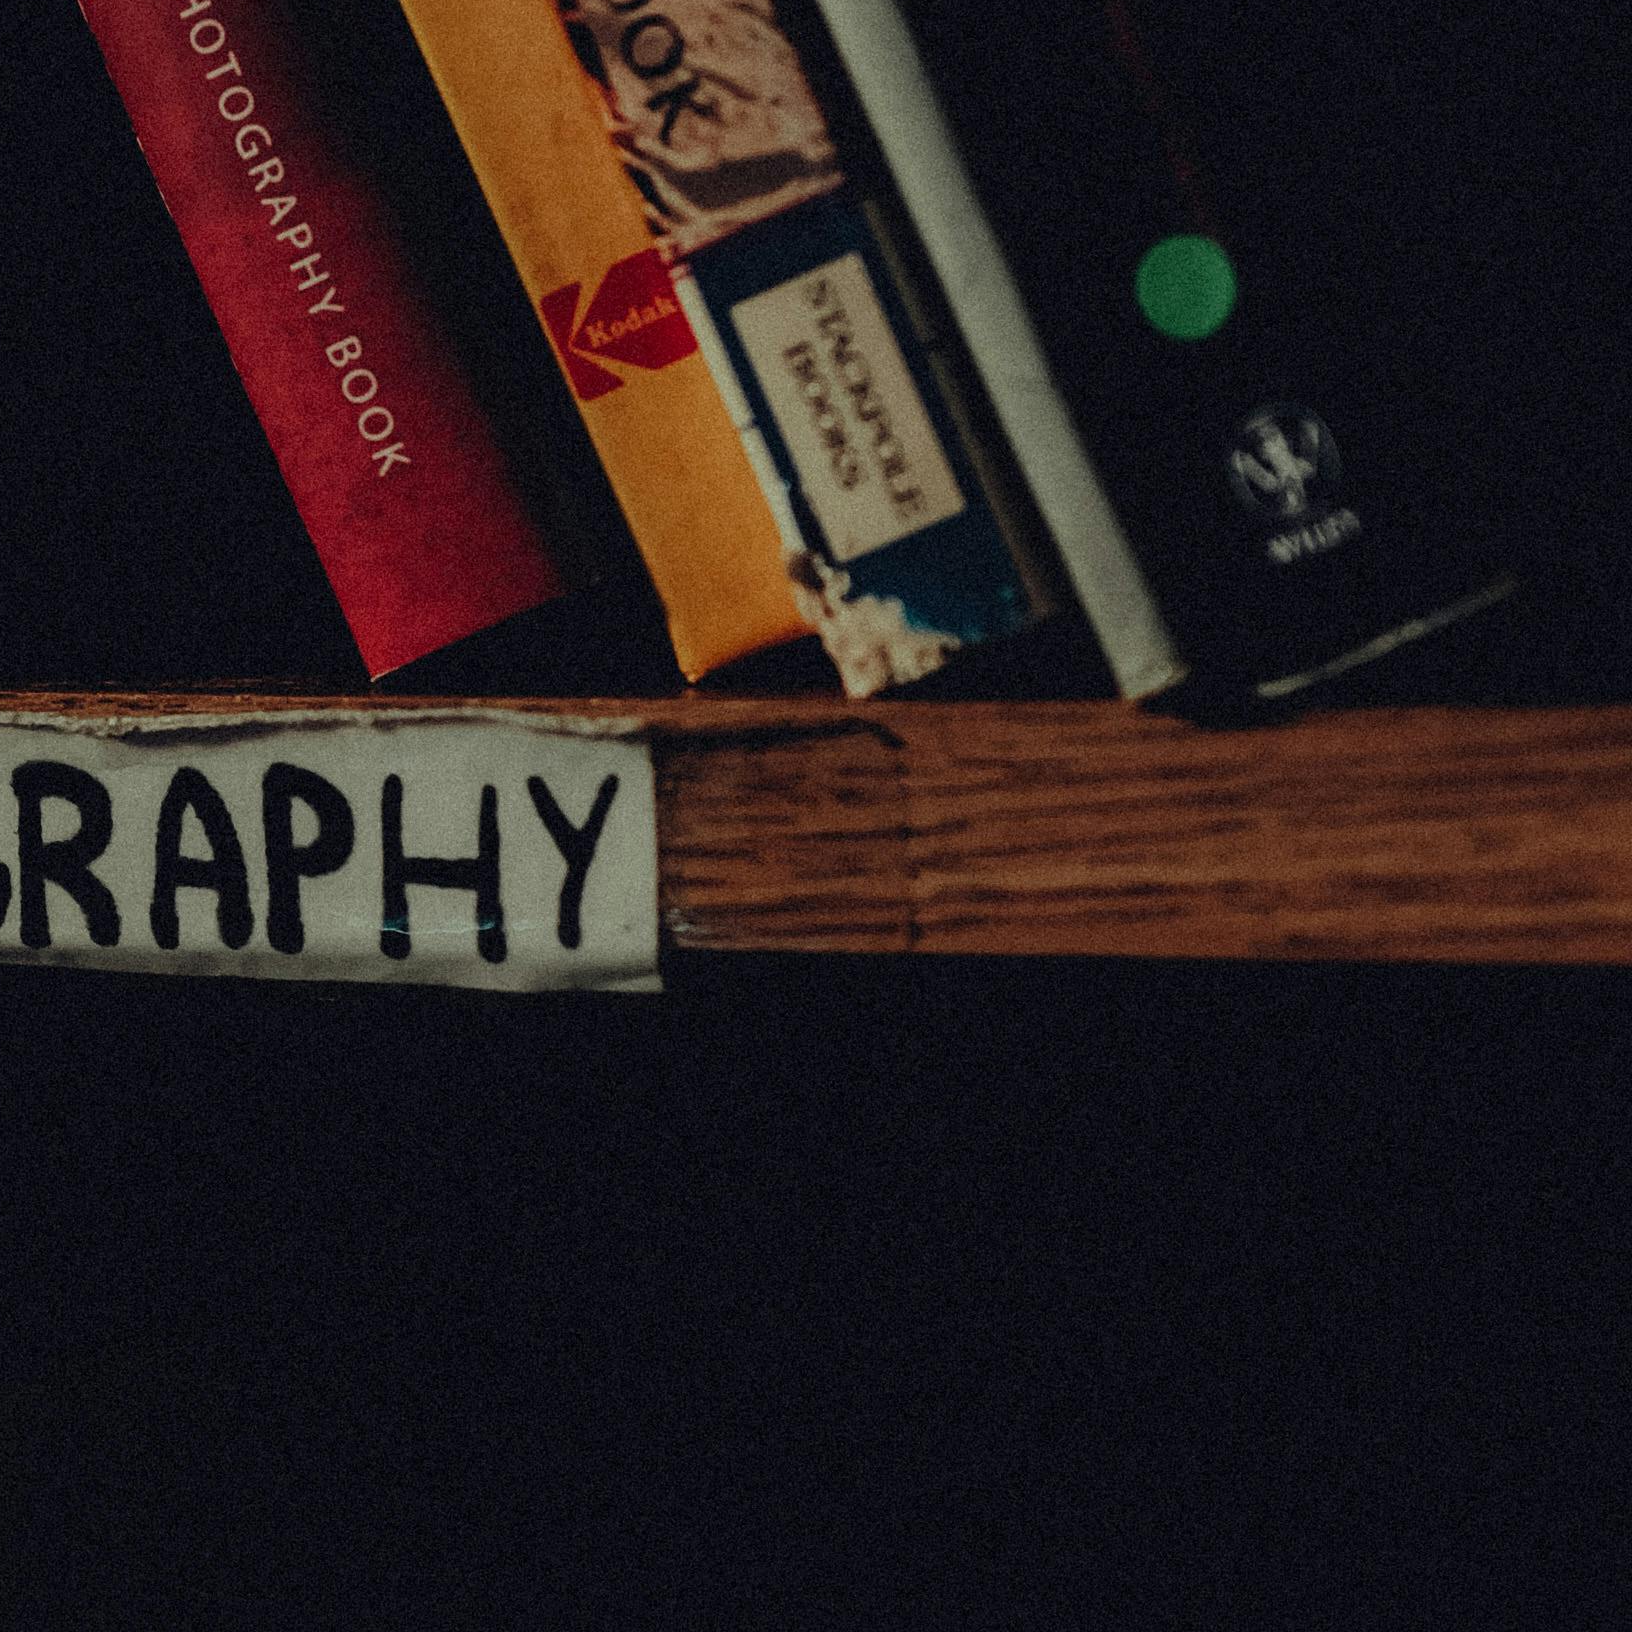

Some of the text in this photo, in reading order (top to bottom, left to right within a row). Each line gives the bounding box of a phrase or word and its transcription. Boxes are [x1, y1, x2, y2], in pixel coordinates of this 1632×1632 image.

[586, 292, 682, 349] Kodak
[324, 335, 413, 480] BOOK
[780, 342, 866, 493] BOOKS
